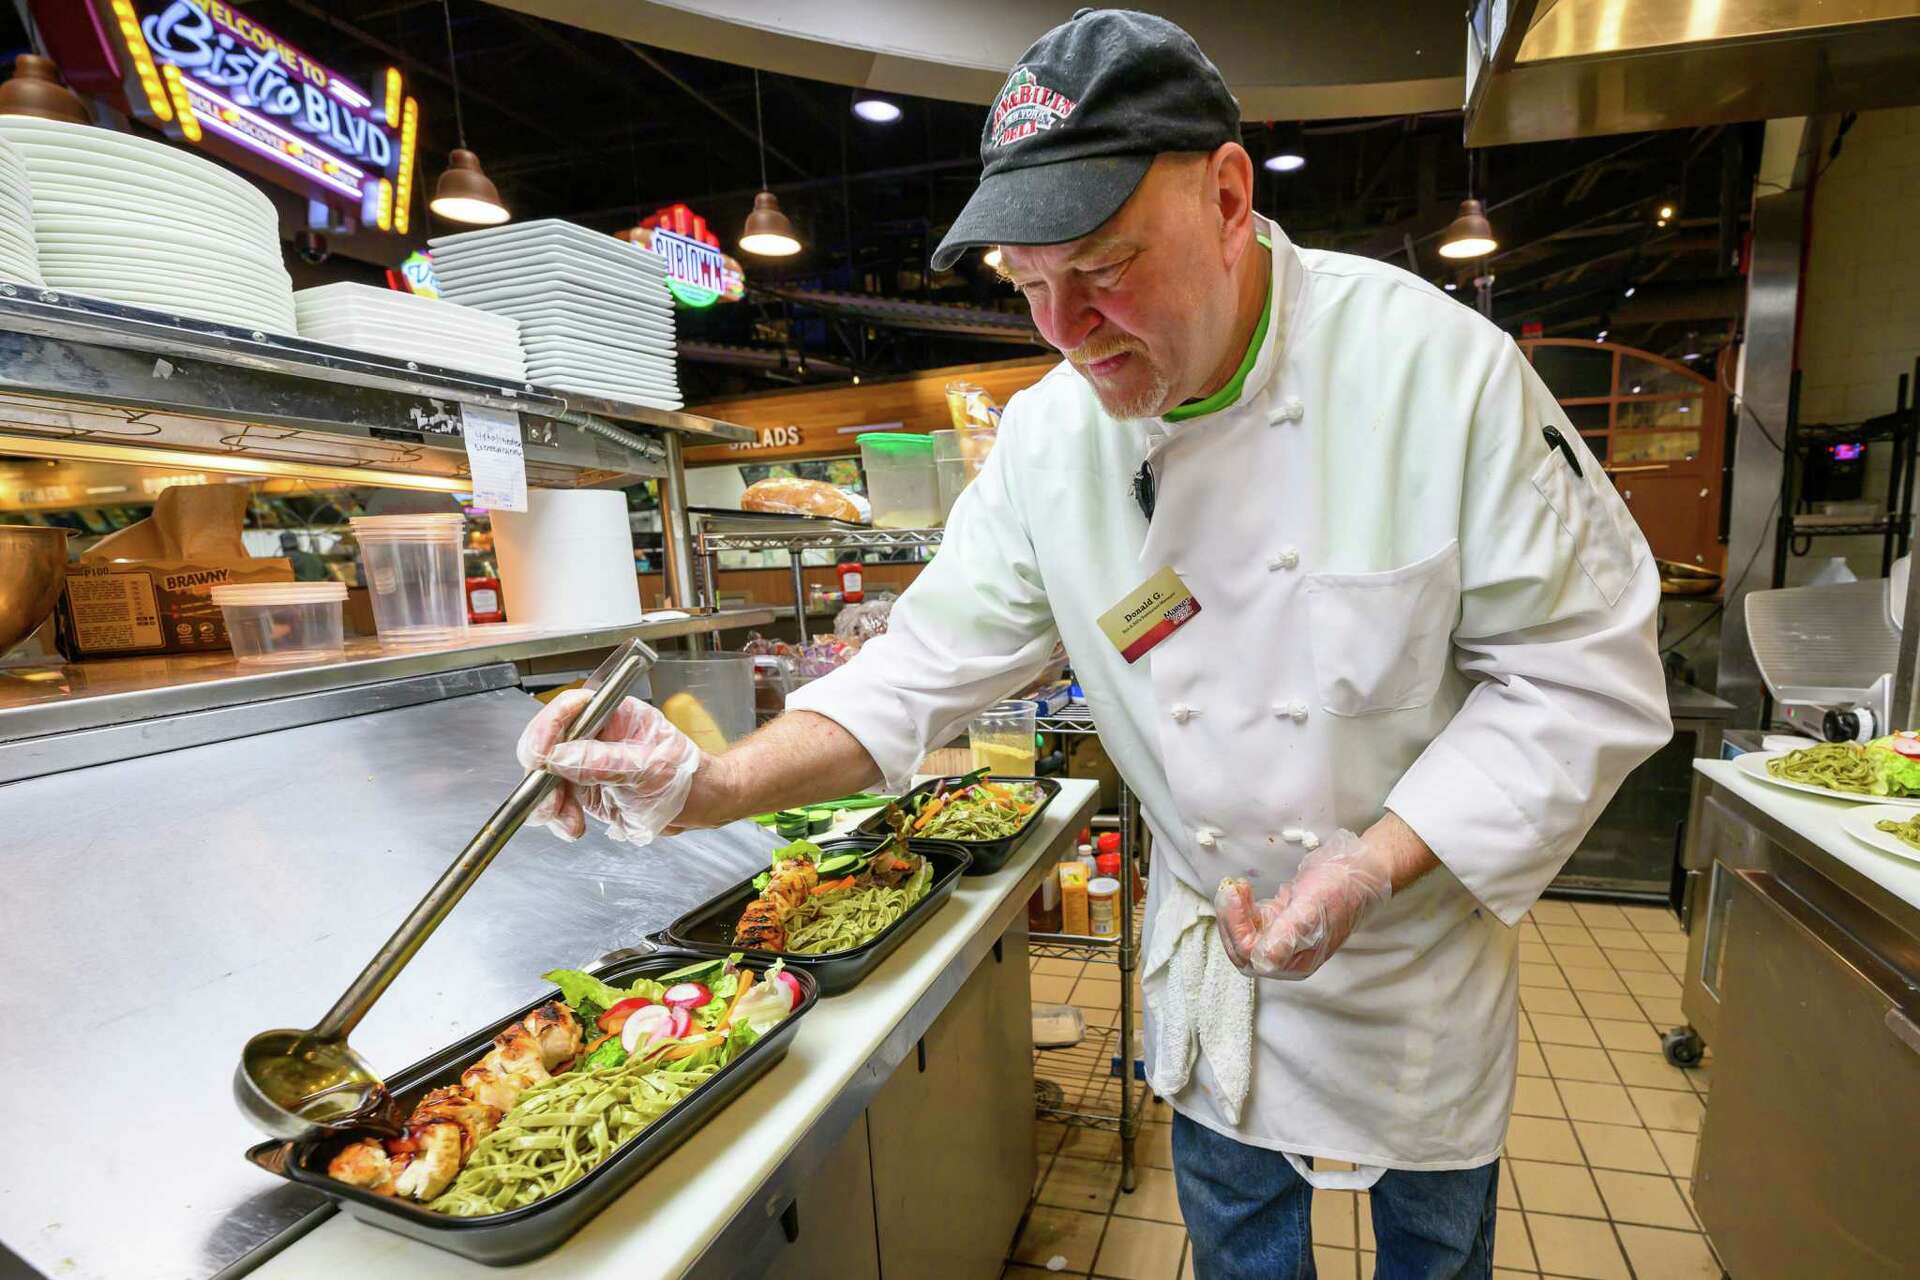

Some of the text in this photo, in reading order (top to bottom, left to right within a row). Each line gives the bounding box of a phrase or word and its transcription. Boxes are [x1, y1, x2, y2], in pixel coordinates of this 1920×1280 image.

[142, 0, 391, 167] Bistro BLVD
[299, 56, 328, 87] TO
[166, 569, 228, 589] BRAWNY
[1124, 597, 1153, 622] Donald
[1152, 592, 1164, 601] G.
